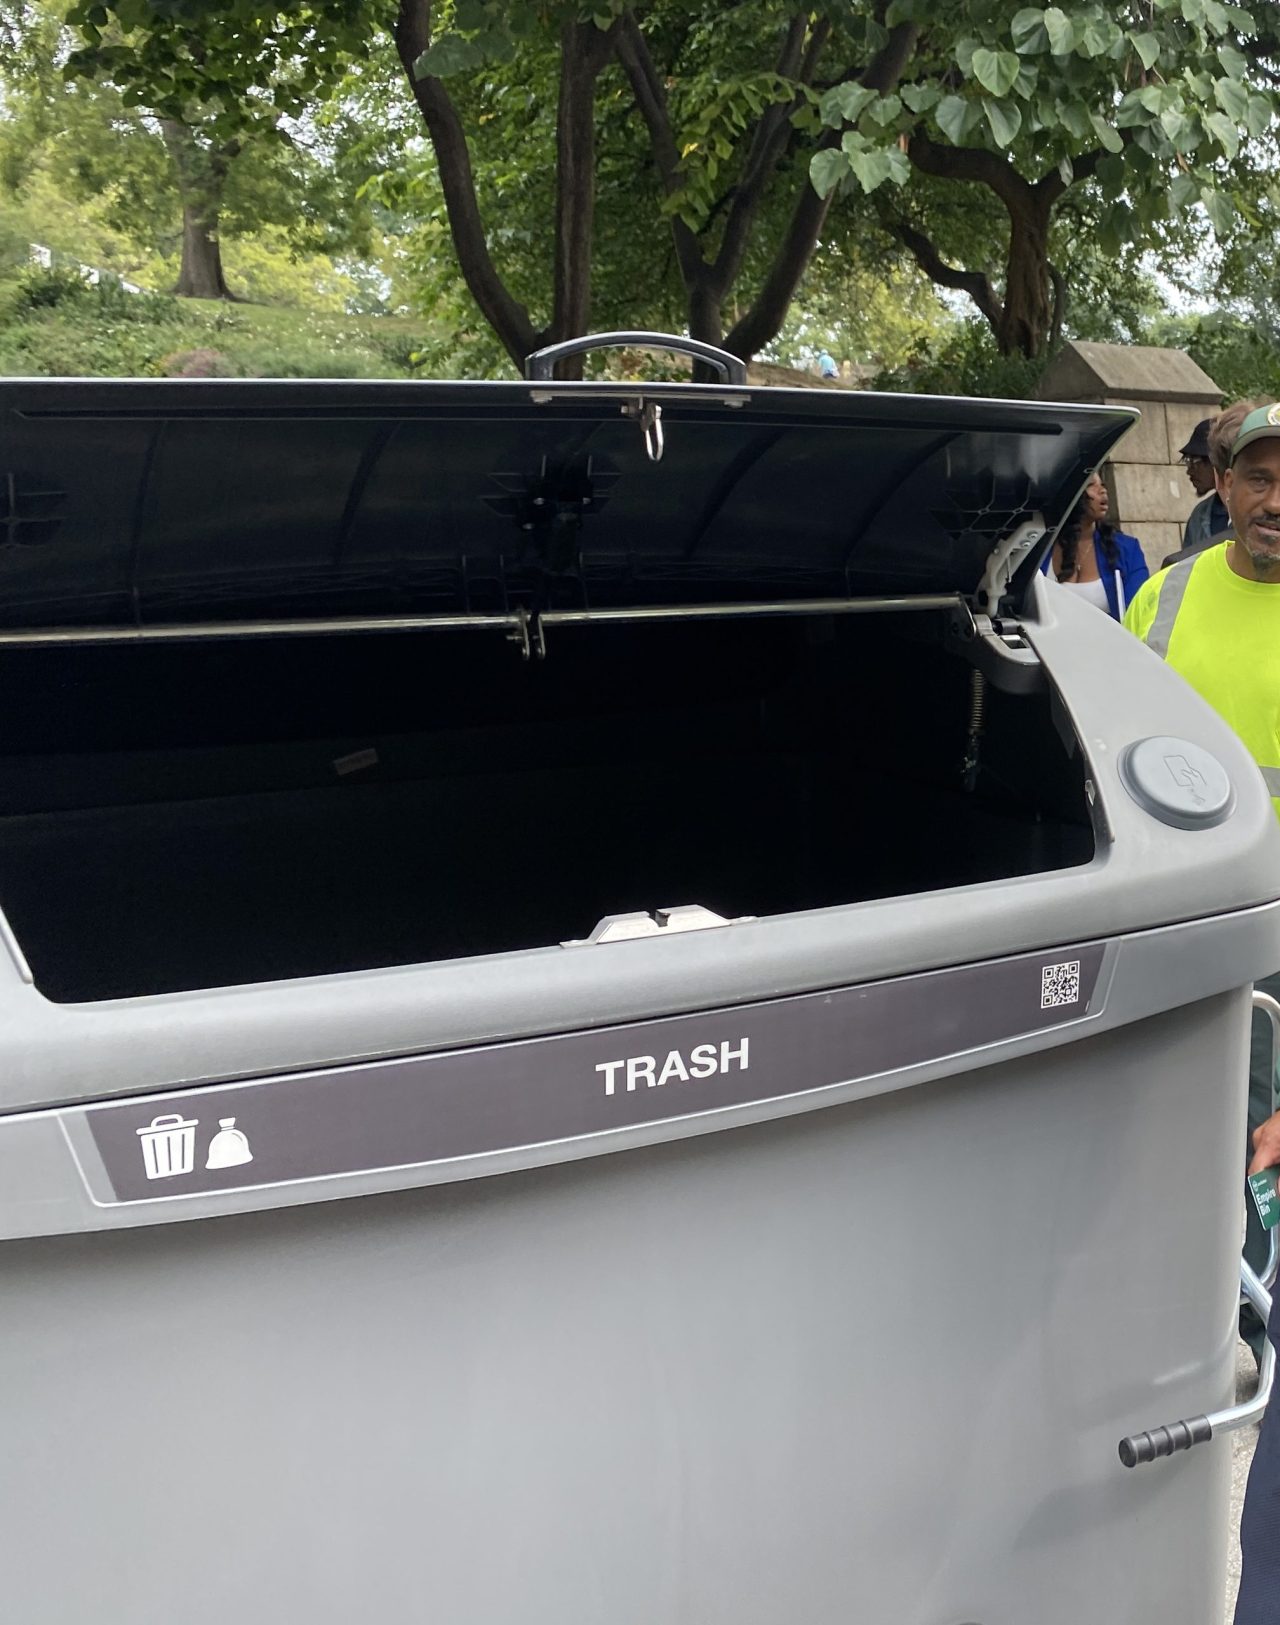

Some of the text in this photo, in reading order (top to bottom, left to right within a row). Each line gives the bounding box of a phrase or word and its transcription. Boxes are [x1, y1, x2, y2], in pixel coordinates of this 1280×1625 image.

[595, 1037, 749, 1096] TRASH
[1256, 1189, 1276, 1204] Empire
[1259, 1204, 1271, 1216] Bin
